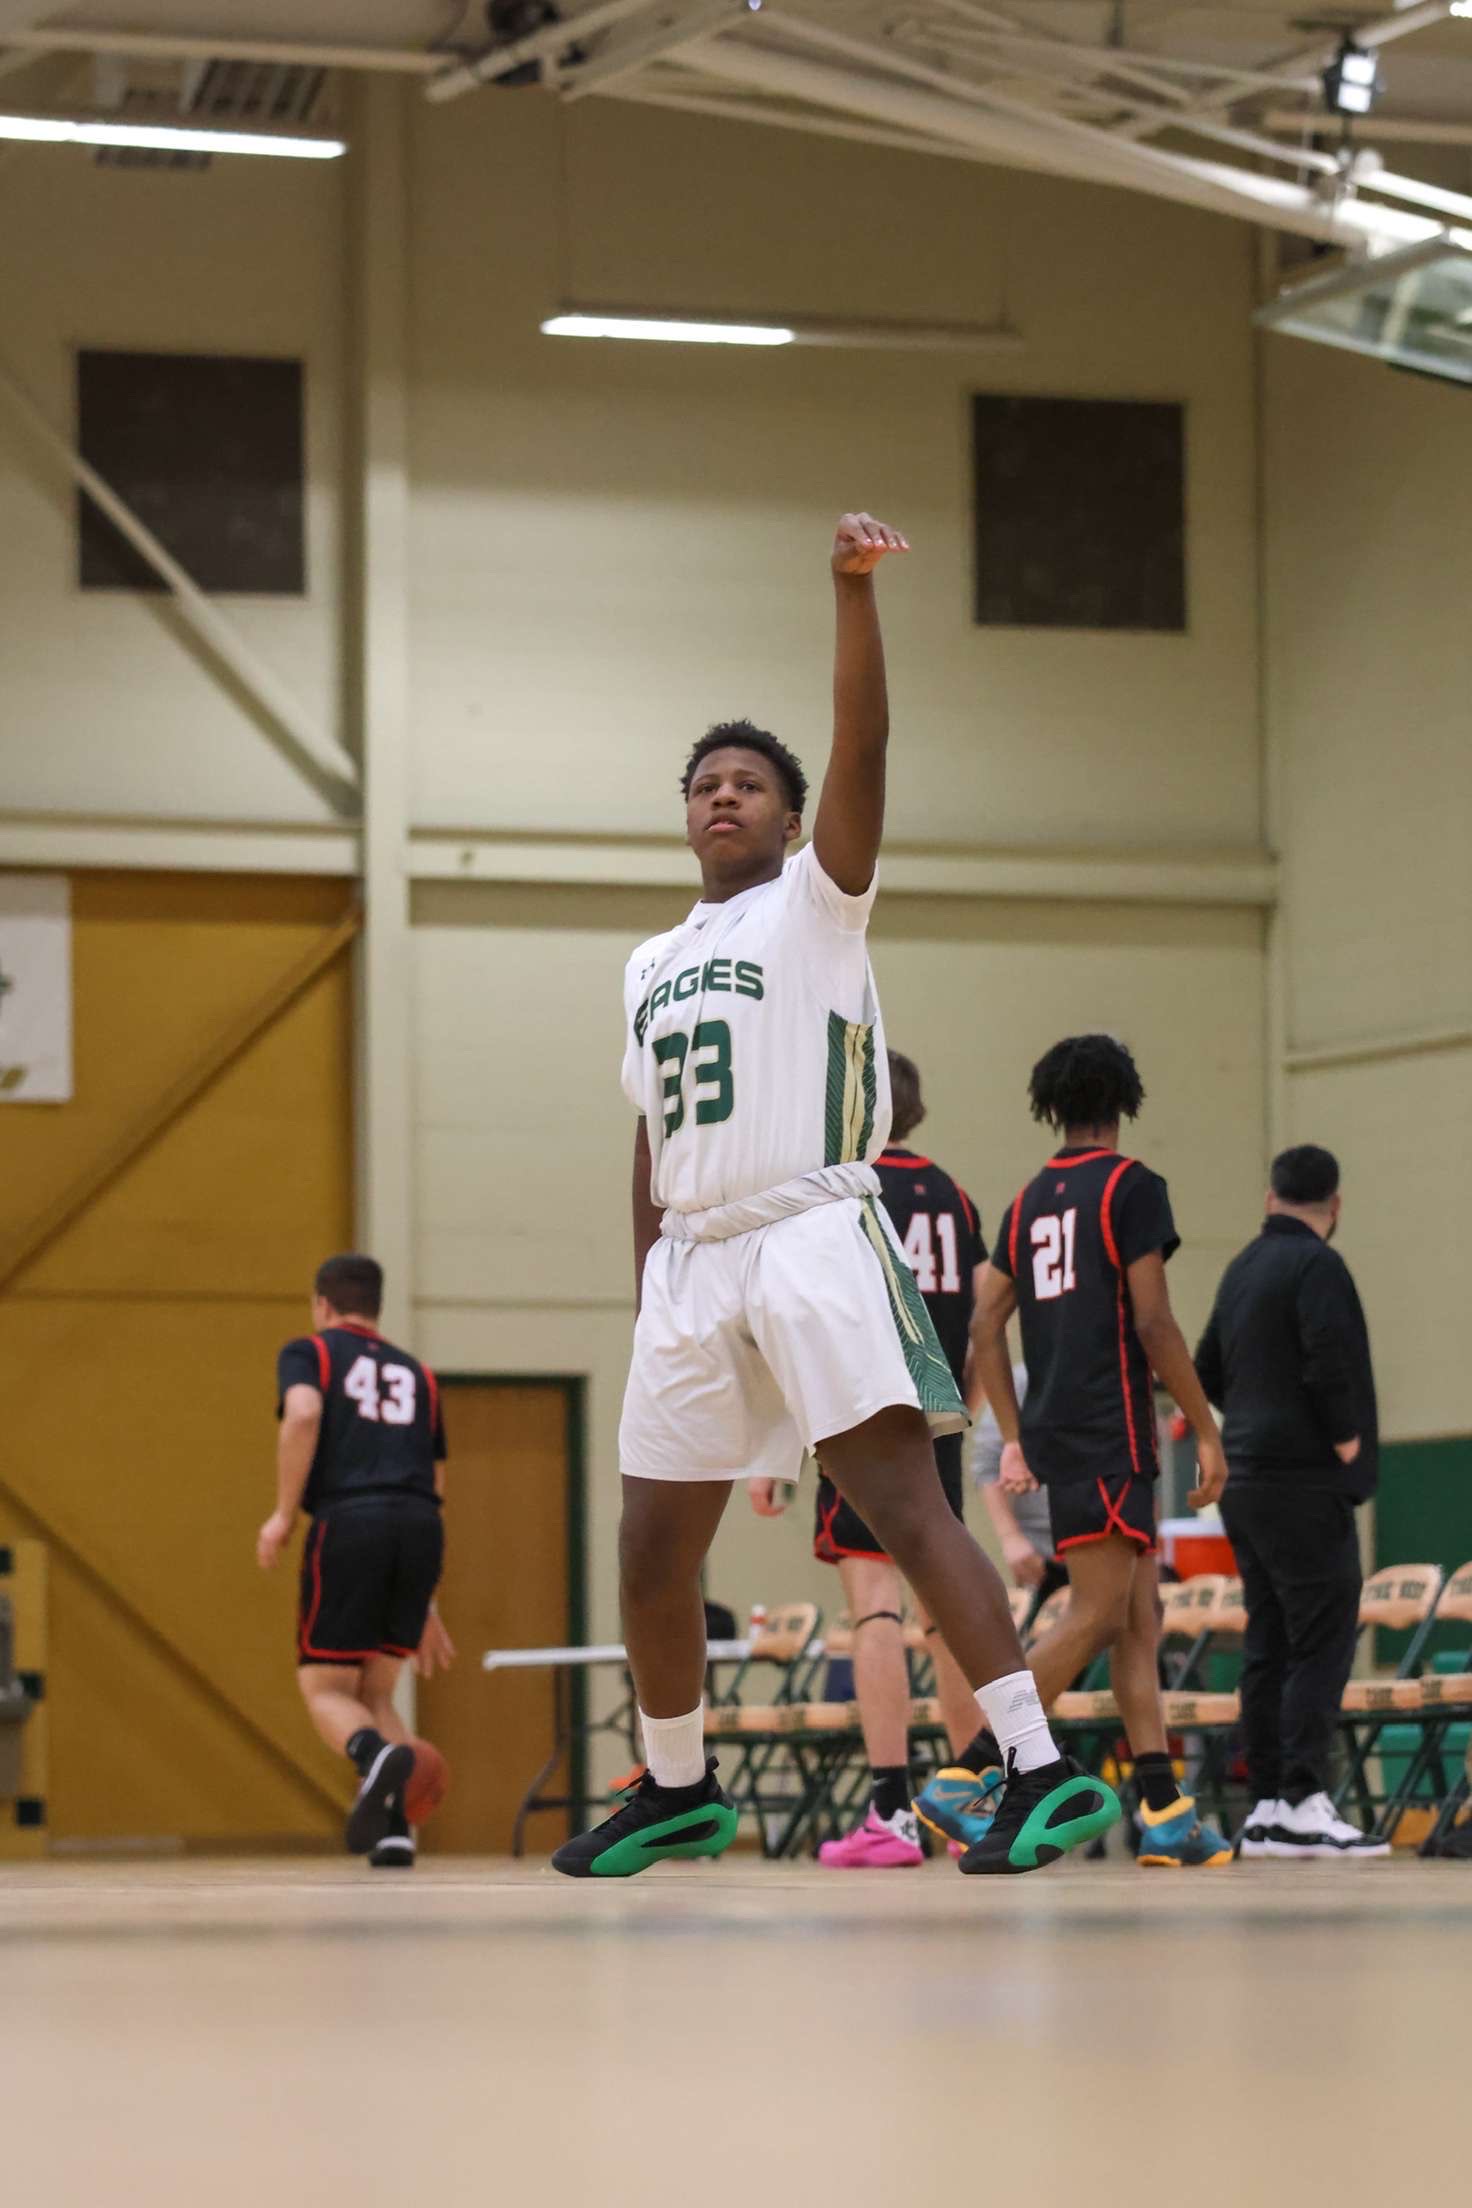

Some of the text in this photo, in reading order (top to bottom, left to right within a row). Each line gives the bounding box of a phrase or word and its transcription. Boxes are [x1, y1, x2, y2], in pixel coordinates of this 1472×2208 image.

[651, 1019, 735, 1139] 33
[902, 1212, 961, 1293] 41
[1030, 1208, 1078, 1300] 21
[344, 1355, 416, 1424] 43
